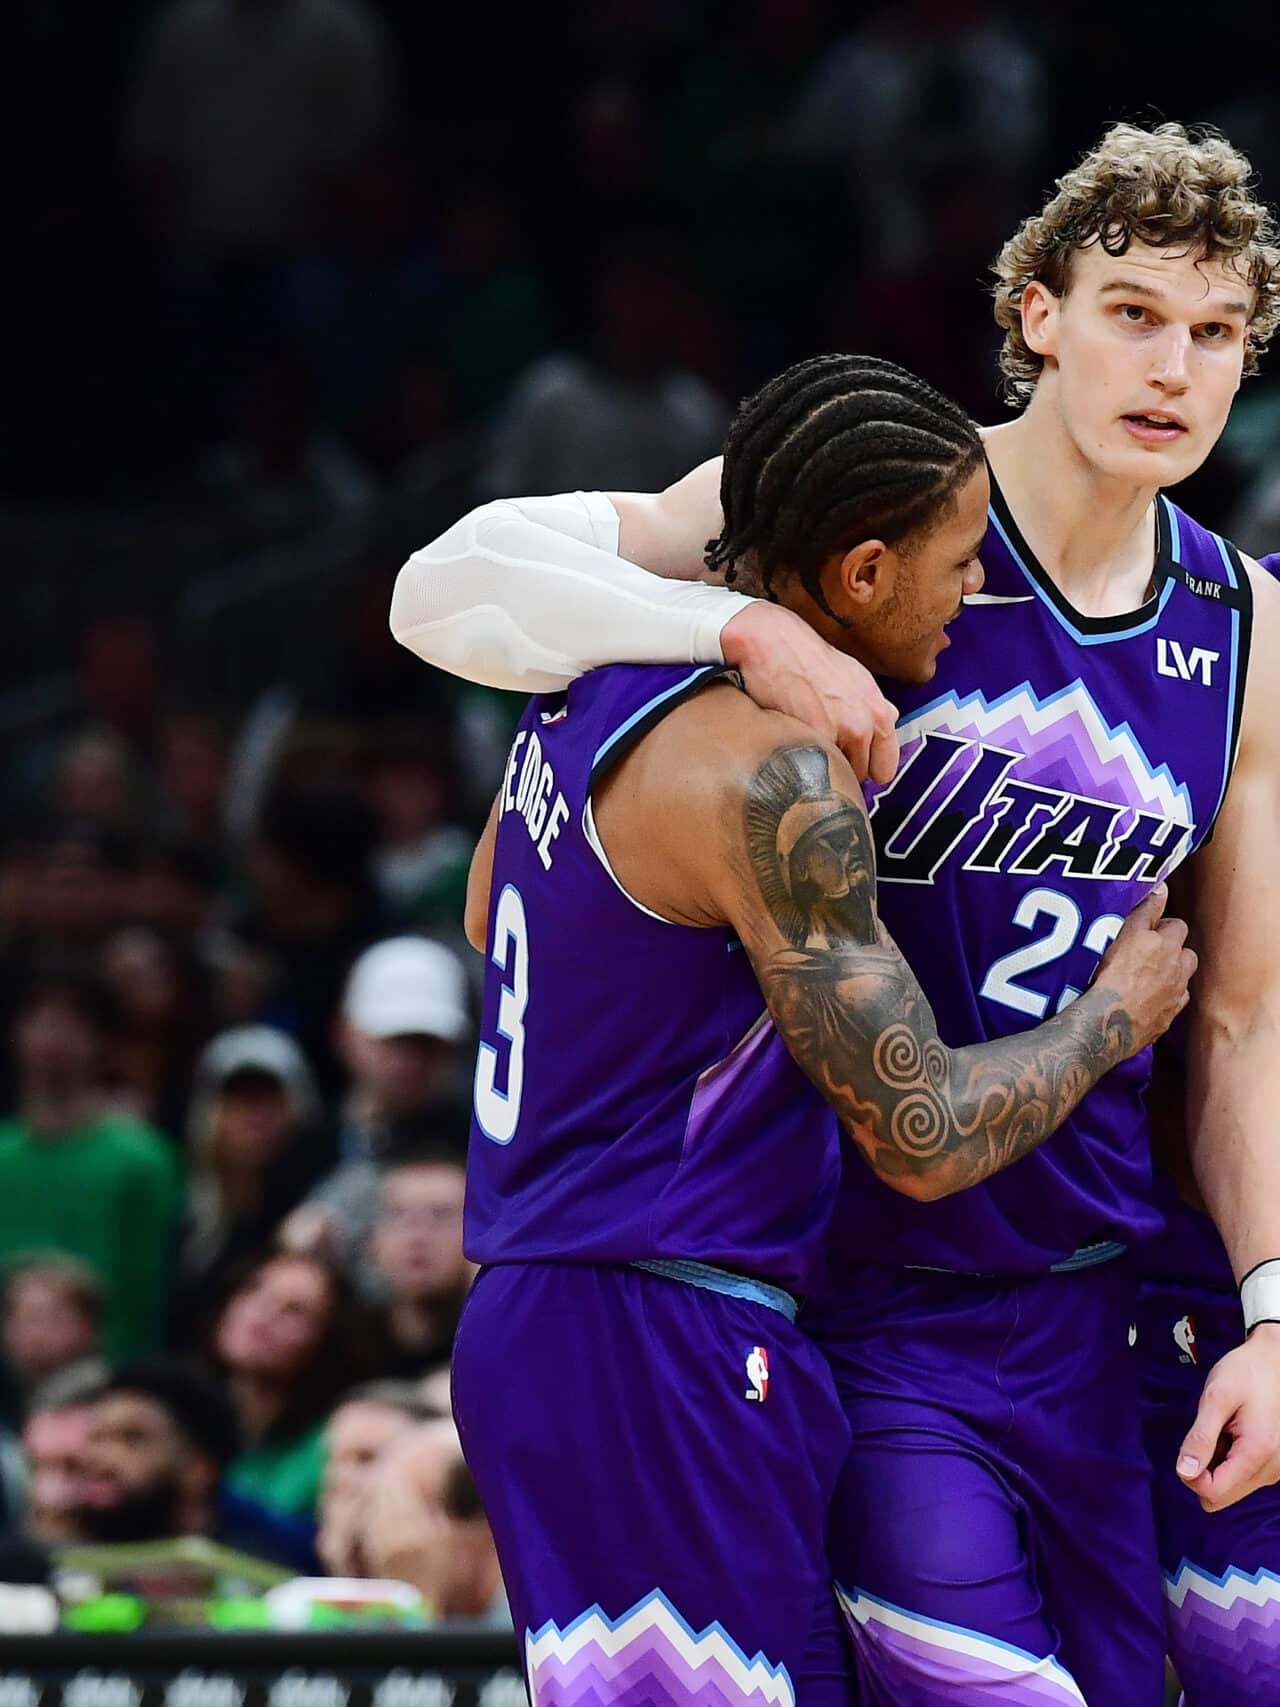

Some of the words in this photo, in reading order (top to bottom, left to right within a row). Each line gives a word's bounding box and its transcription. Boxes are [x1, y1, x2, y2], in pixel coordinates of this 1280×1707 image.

[1157, 638, 1220, 686] LVT
[868, 729, 1196, 884] UTAH
[474, 883, 529, 1145] 3
